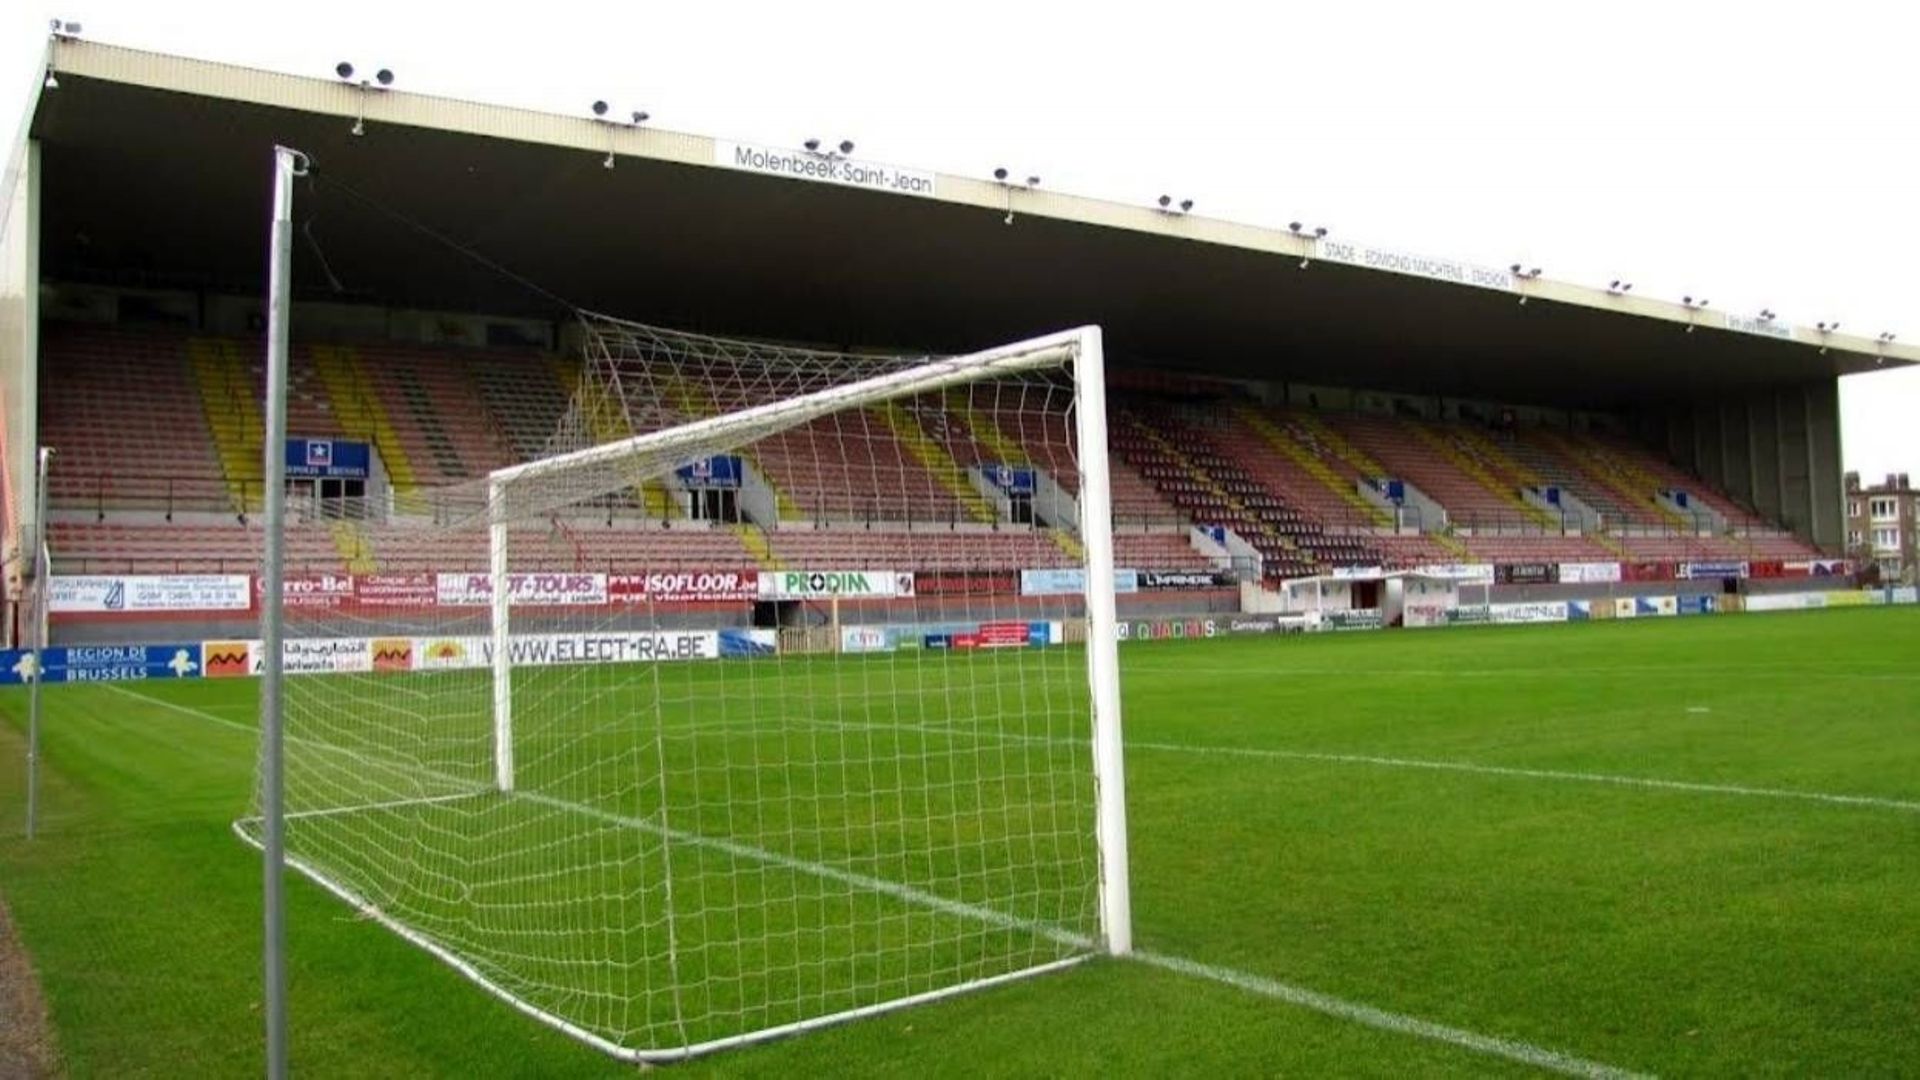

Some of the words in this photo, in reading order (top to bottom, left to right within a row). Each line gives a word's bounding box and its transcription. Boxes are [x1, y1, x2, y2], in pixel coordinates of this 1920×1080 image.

[736, 146, 932, 193] Molenbeek-Saint-Jean
[1324, 242, 1356, 262] STADE
[1364, 249, 1411, 271] EDMOND
[1413, 256, 1464, 281] MACHTENS
[256, 575, 354, 593] Crro-Bel
[785, 573, 871, 593] PRODIM
[66, 666, 147, 682] BRUSSELS
